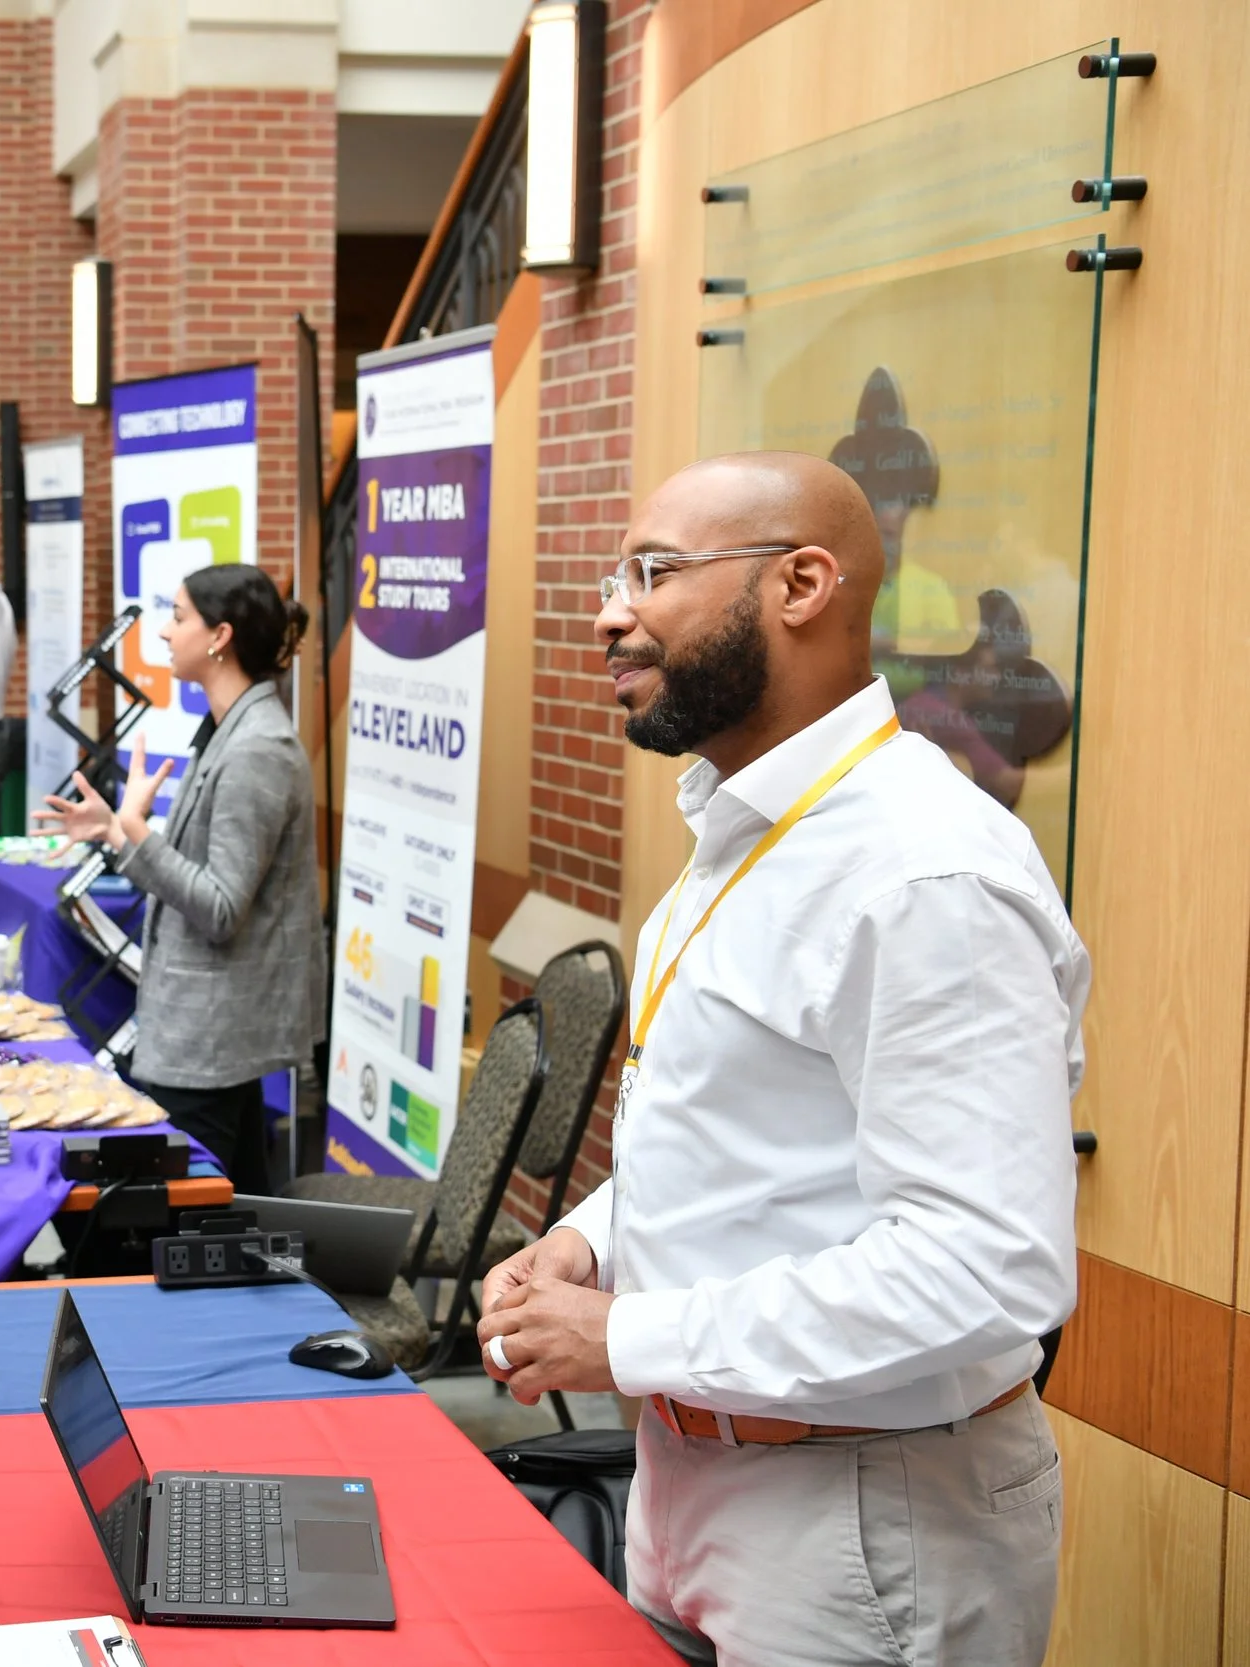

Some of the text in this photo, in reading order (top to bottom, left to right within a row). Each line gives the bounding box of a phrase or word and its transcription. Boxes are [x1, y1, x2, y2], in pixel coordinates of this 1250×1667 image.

[179, 398, 248, 433] TECHNOLOGY
[366, 478, 466, 534] 1 YEAR MBA
[358, 553, 466, 610] 2 INTERNATIONAL
[377, 584, 451, 613] STUDY TOURS
[455, 687, 469, 708] IN
[1004, 670, 1052, 691] Shannon
[350, 699, 467, 760] CLEVELAND
